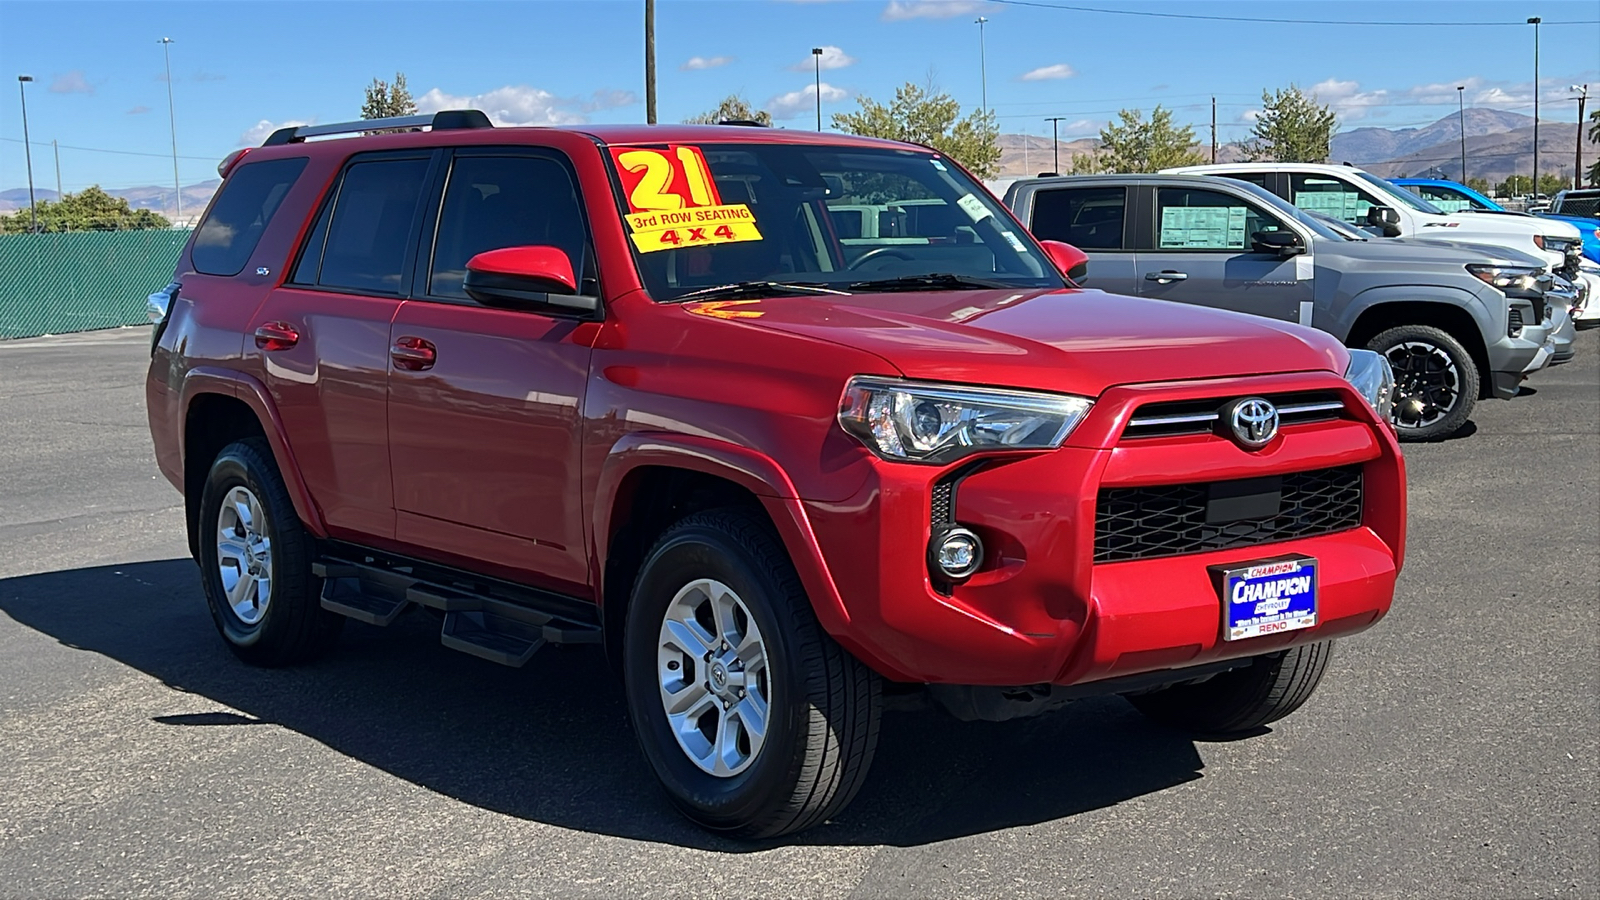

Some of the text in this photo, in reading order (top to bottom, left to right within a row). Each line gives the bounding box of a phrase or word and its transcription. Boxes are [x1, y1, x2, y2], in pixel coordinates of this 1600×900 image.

[618, 146, 712, 210] 21
[634, 208, 750, 229] 3rd ROW SEATING
[660, 229, 682, 245] 4
[714, 225, 736, 240] 4
[1251, 562, 1294, 578] CHAMPION
[1232, 575, 1311, 605] CHAMPION
[1257, 600, 1288, 612] CHEVROLET
[1259, 621, 1288, 633] RENO
